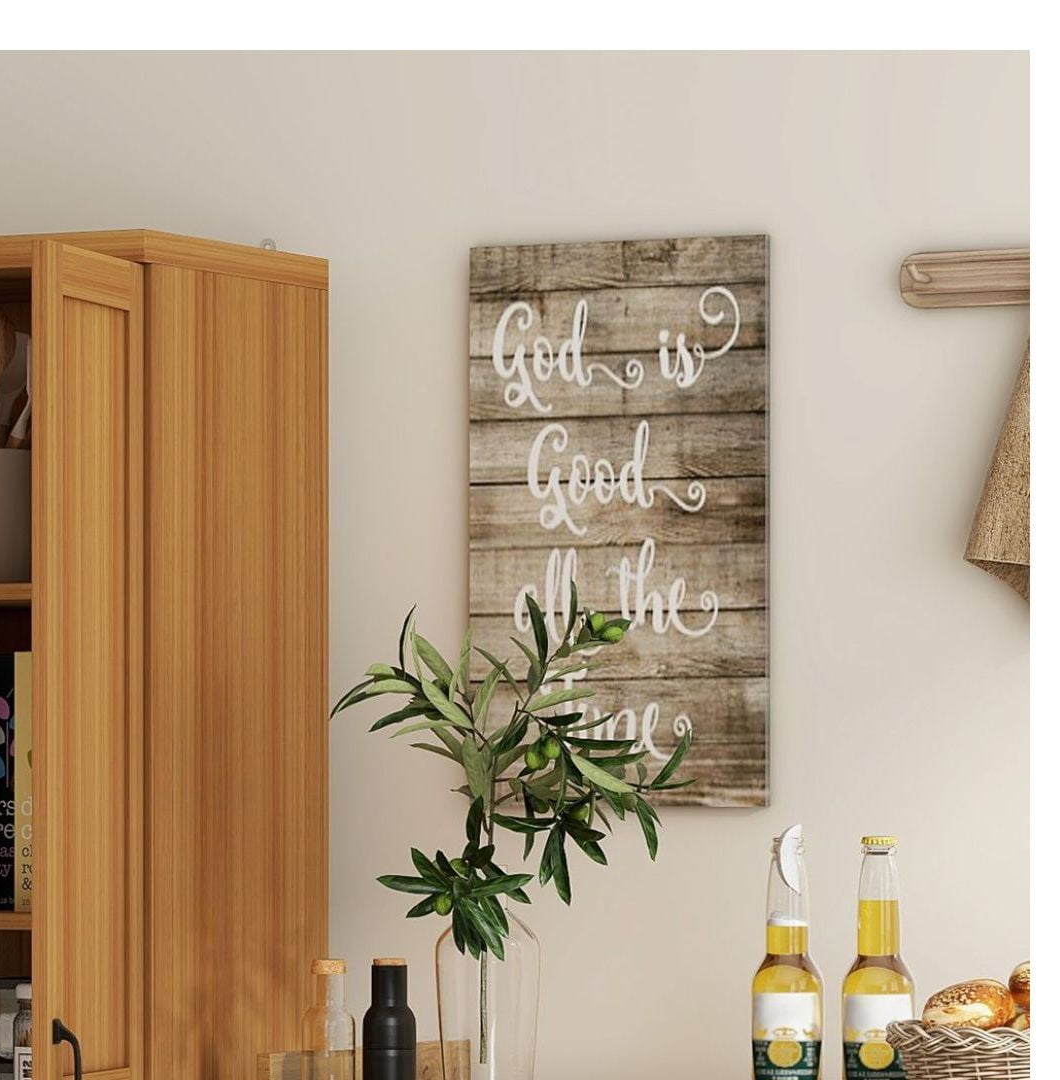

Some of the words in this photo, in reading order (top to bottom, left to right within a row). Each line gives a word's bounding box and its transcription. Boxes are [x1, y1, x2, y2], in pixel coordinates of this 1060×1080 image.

[492, 299, 644, 412] God
[657, 286, 740, 389] is
[528, 420, 707, 536] Good
[605, 537, 719, 636] the
